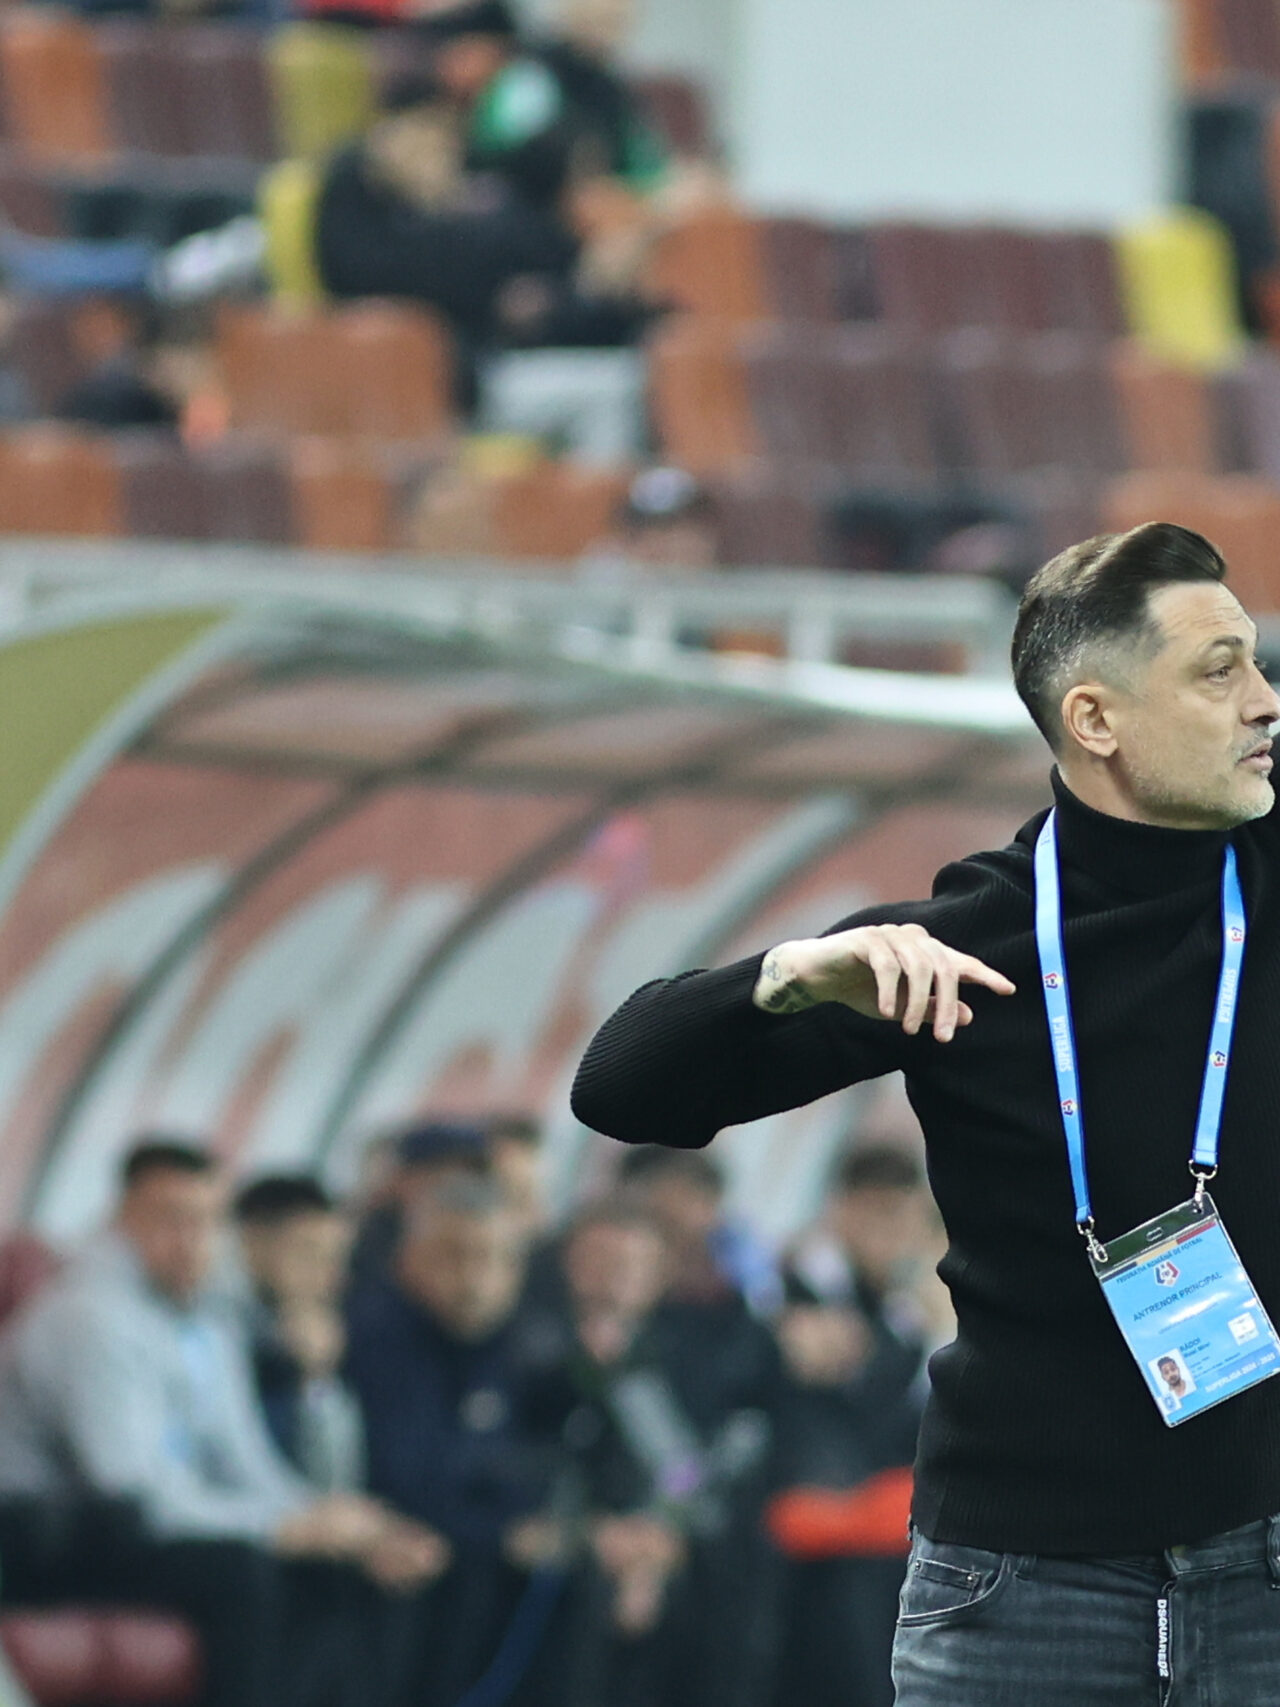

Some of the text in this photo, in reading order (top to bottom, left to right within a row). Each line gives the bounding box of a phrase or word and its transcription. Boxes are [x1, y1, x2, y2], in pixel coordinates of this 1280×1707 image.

[1218, 968, 1236, 1023] SUPERLIGA
[1052, 1015, 1072, 1072] SUPERLIGA
[1132, 1292, 1179, 1321] ANTRENOR
[1178, 1271, 1222, 1298] PRINCIPAL
